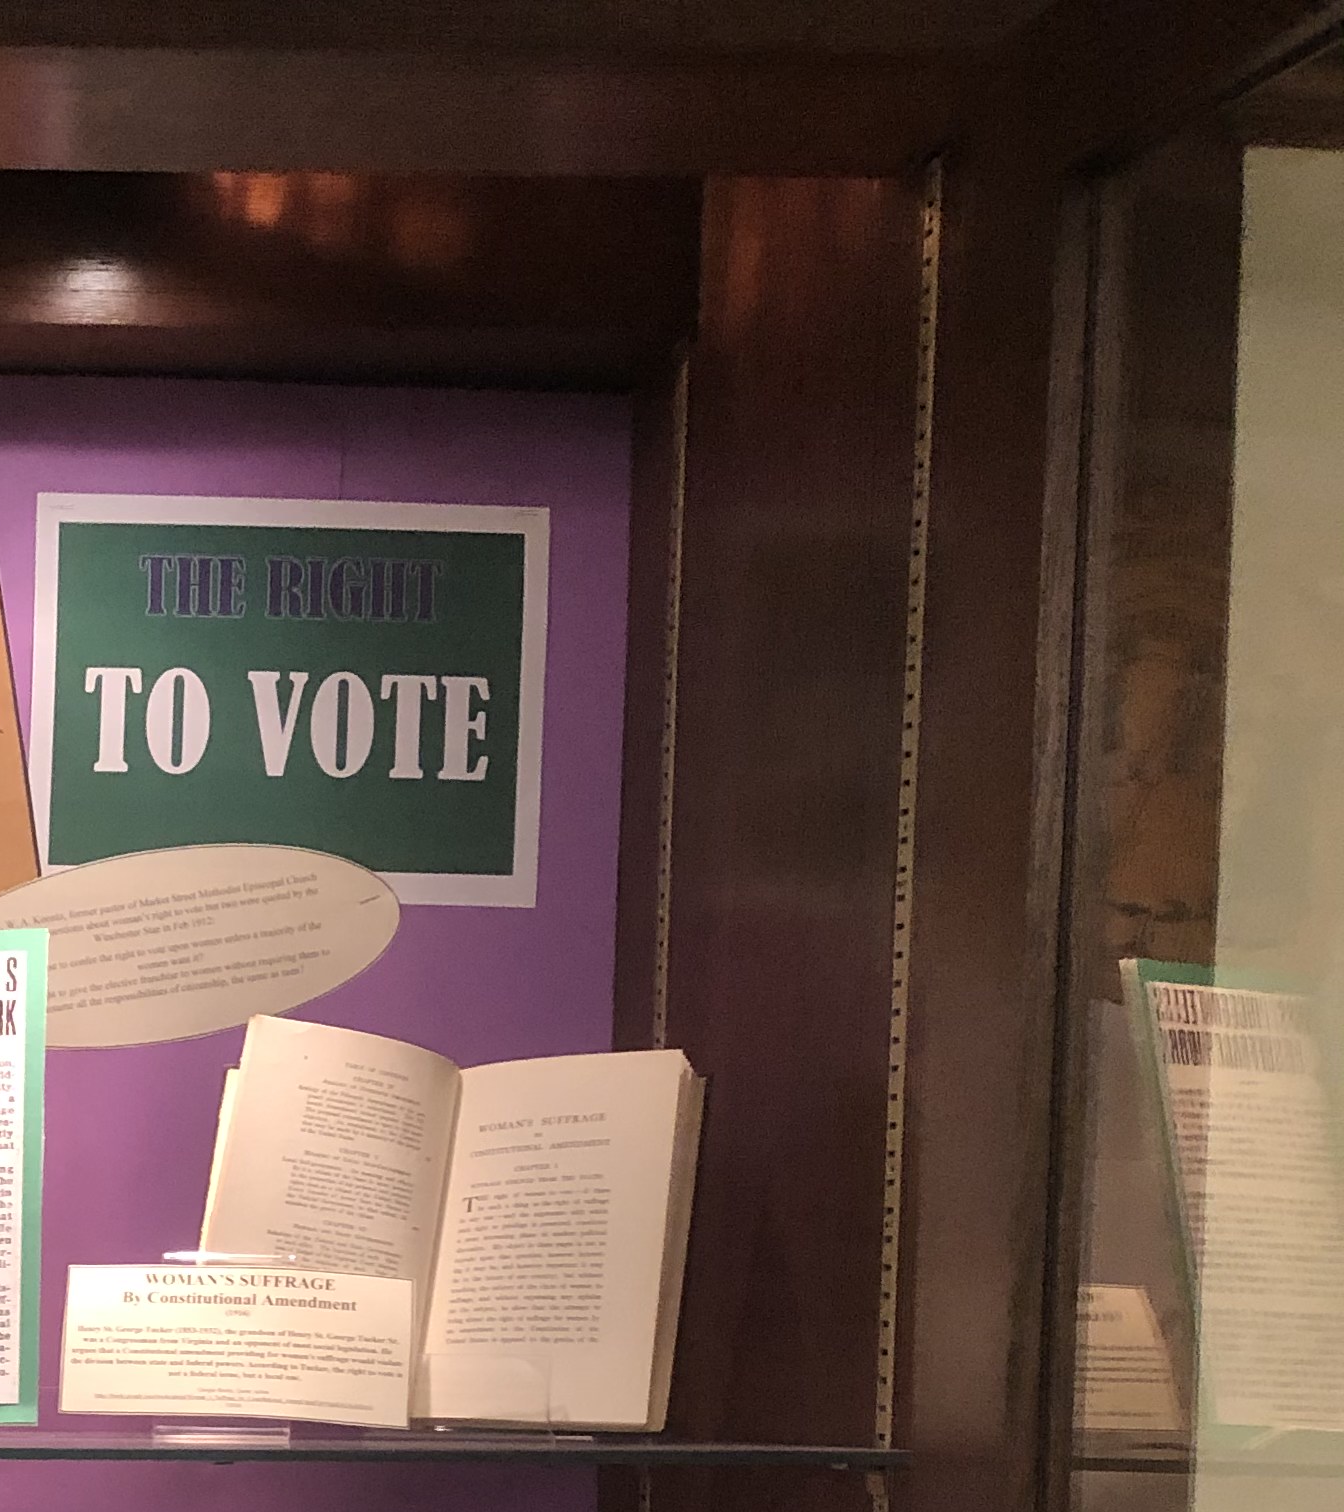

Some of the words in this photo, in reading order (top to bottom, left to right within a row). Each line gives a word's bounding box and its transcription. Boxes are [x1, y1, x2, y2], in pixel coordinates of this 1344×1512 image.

[139, 554, 246, 619] THE
[265, 555, 444, 623] RIGHT
[85, 667, 210, 774] TO
[247, 671, 490, 780] VOTE
[139, 897, 170, 908] Market
[286, 873, 317, 885] Church
[146, 1273, 234, 1287] WOMAN'S
[239, 1274, 336, 1291] SUFFRAGE
[123, 1291, 140, 1306] By
[147, 1291, 257, 1307] Constitutional
[262, 1294, 357, 1311] Amendment
